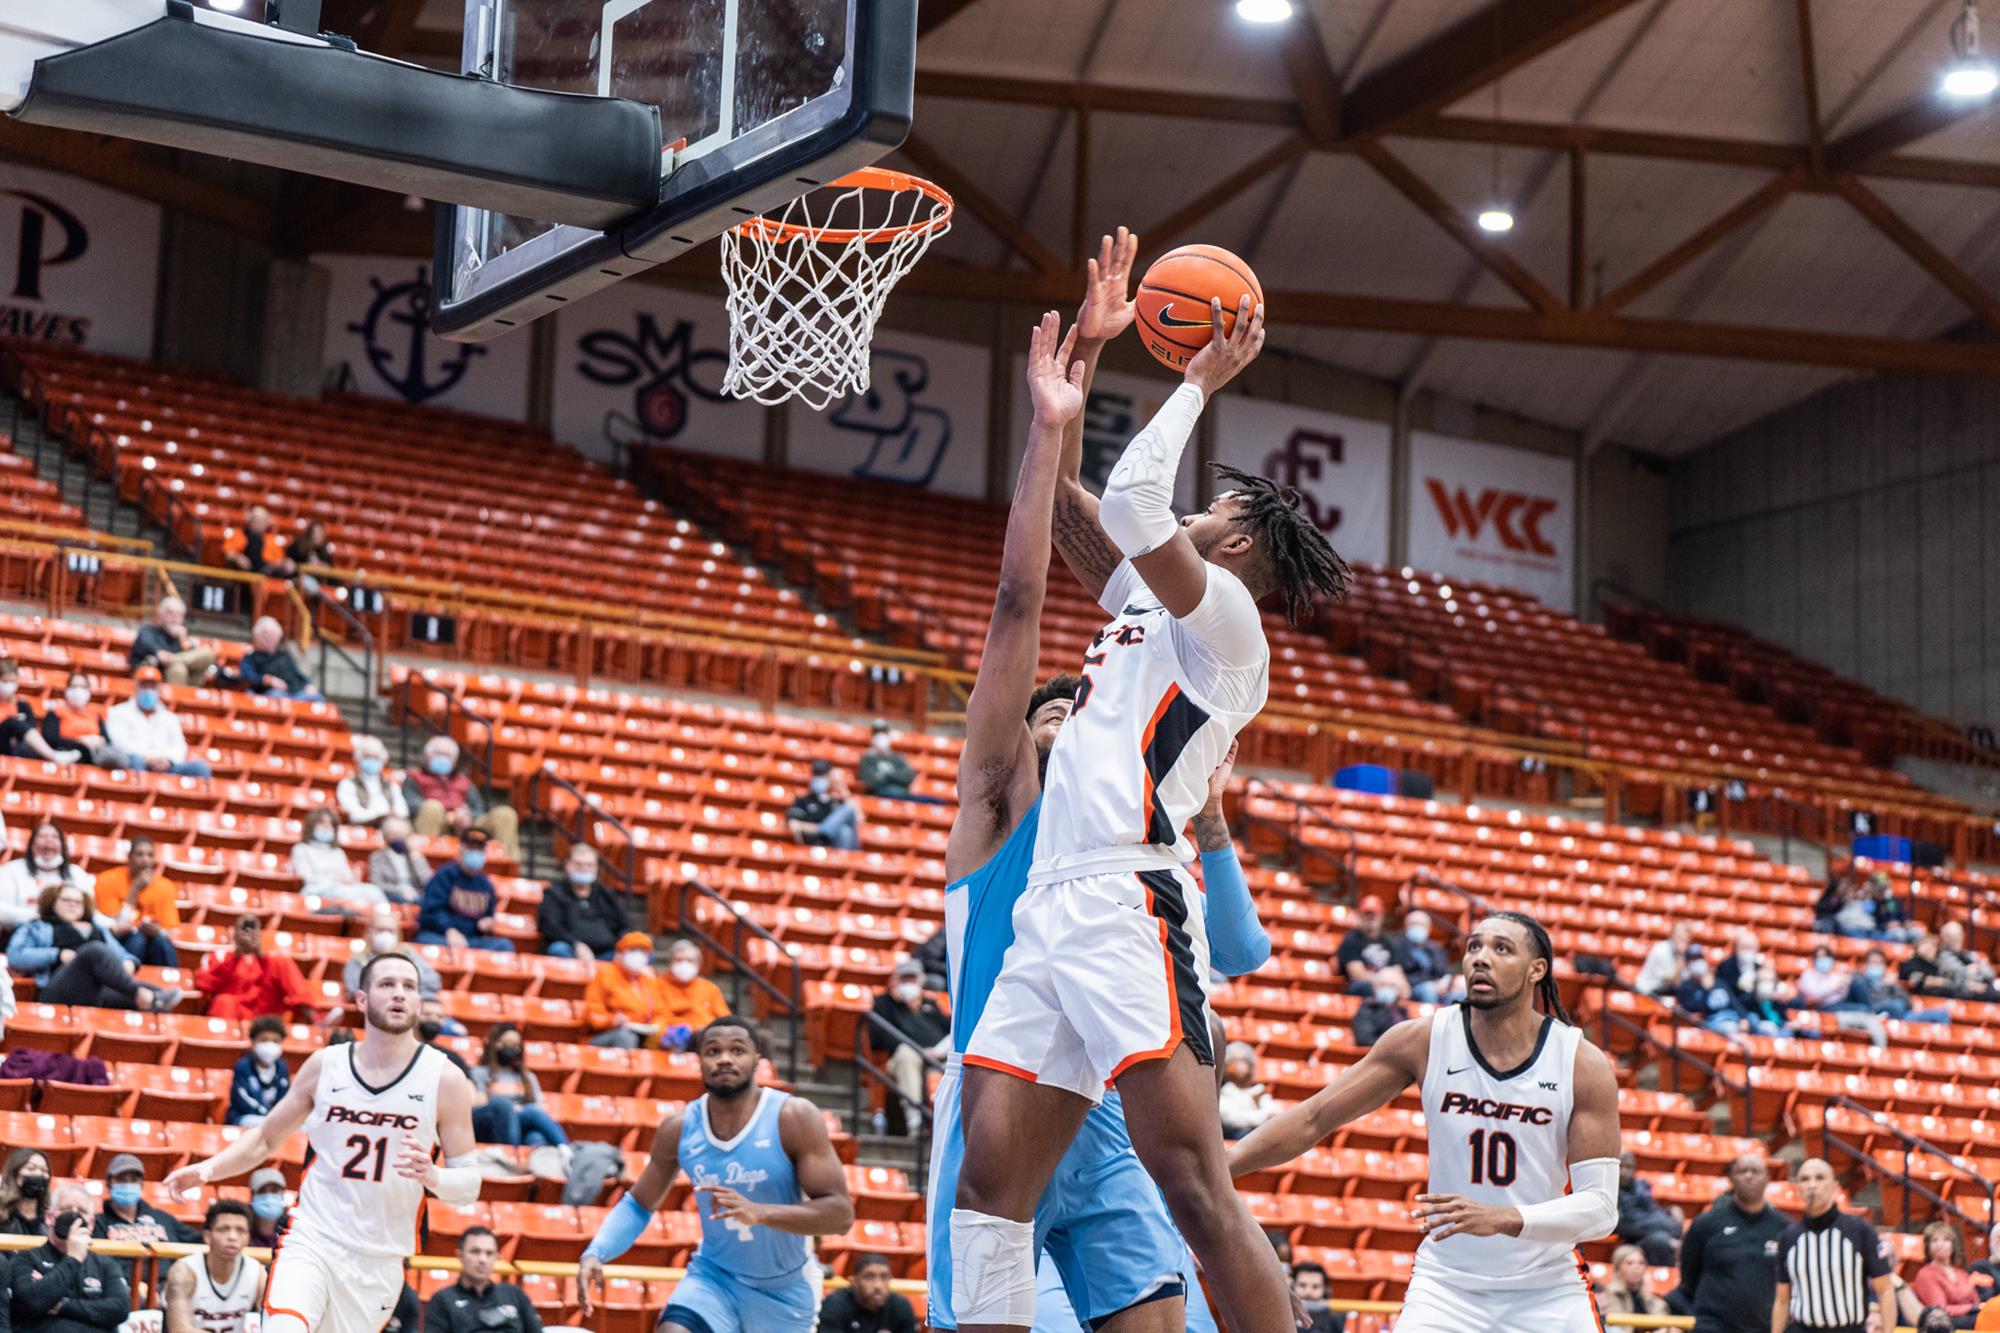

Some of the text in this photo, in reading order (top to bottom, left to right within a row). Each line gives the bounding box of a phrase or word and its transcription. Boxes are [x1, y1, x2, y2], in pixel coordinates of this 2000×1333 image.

[0, 305, 91, 344] AVES
[1424, 476, 1559, 560] WCC
[1538, 1081, 1558, 1092] WCC
[325, 1105, 419, 1130] PACIFIC
[1440, 1091, 1553, 1126] PACIFIC
[341, 1133, 388, 1183] 21
[1468, 1127, 1517, 1187] 10
[725, 1161, 769, 1192] Diego
